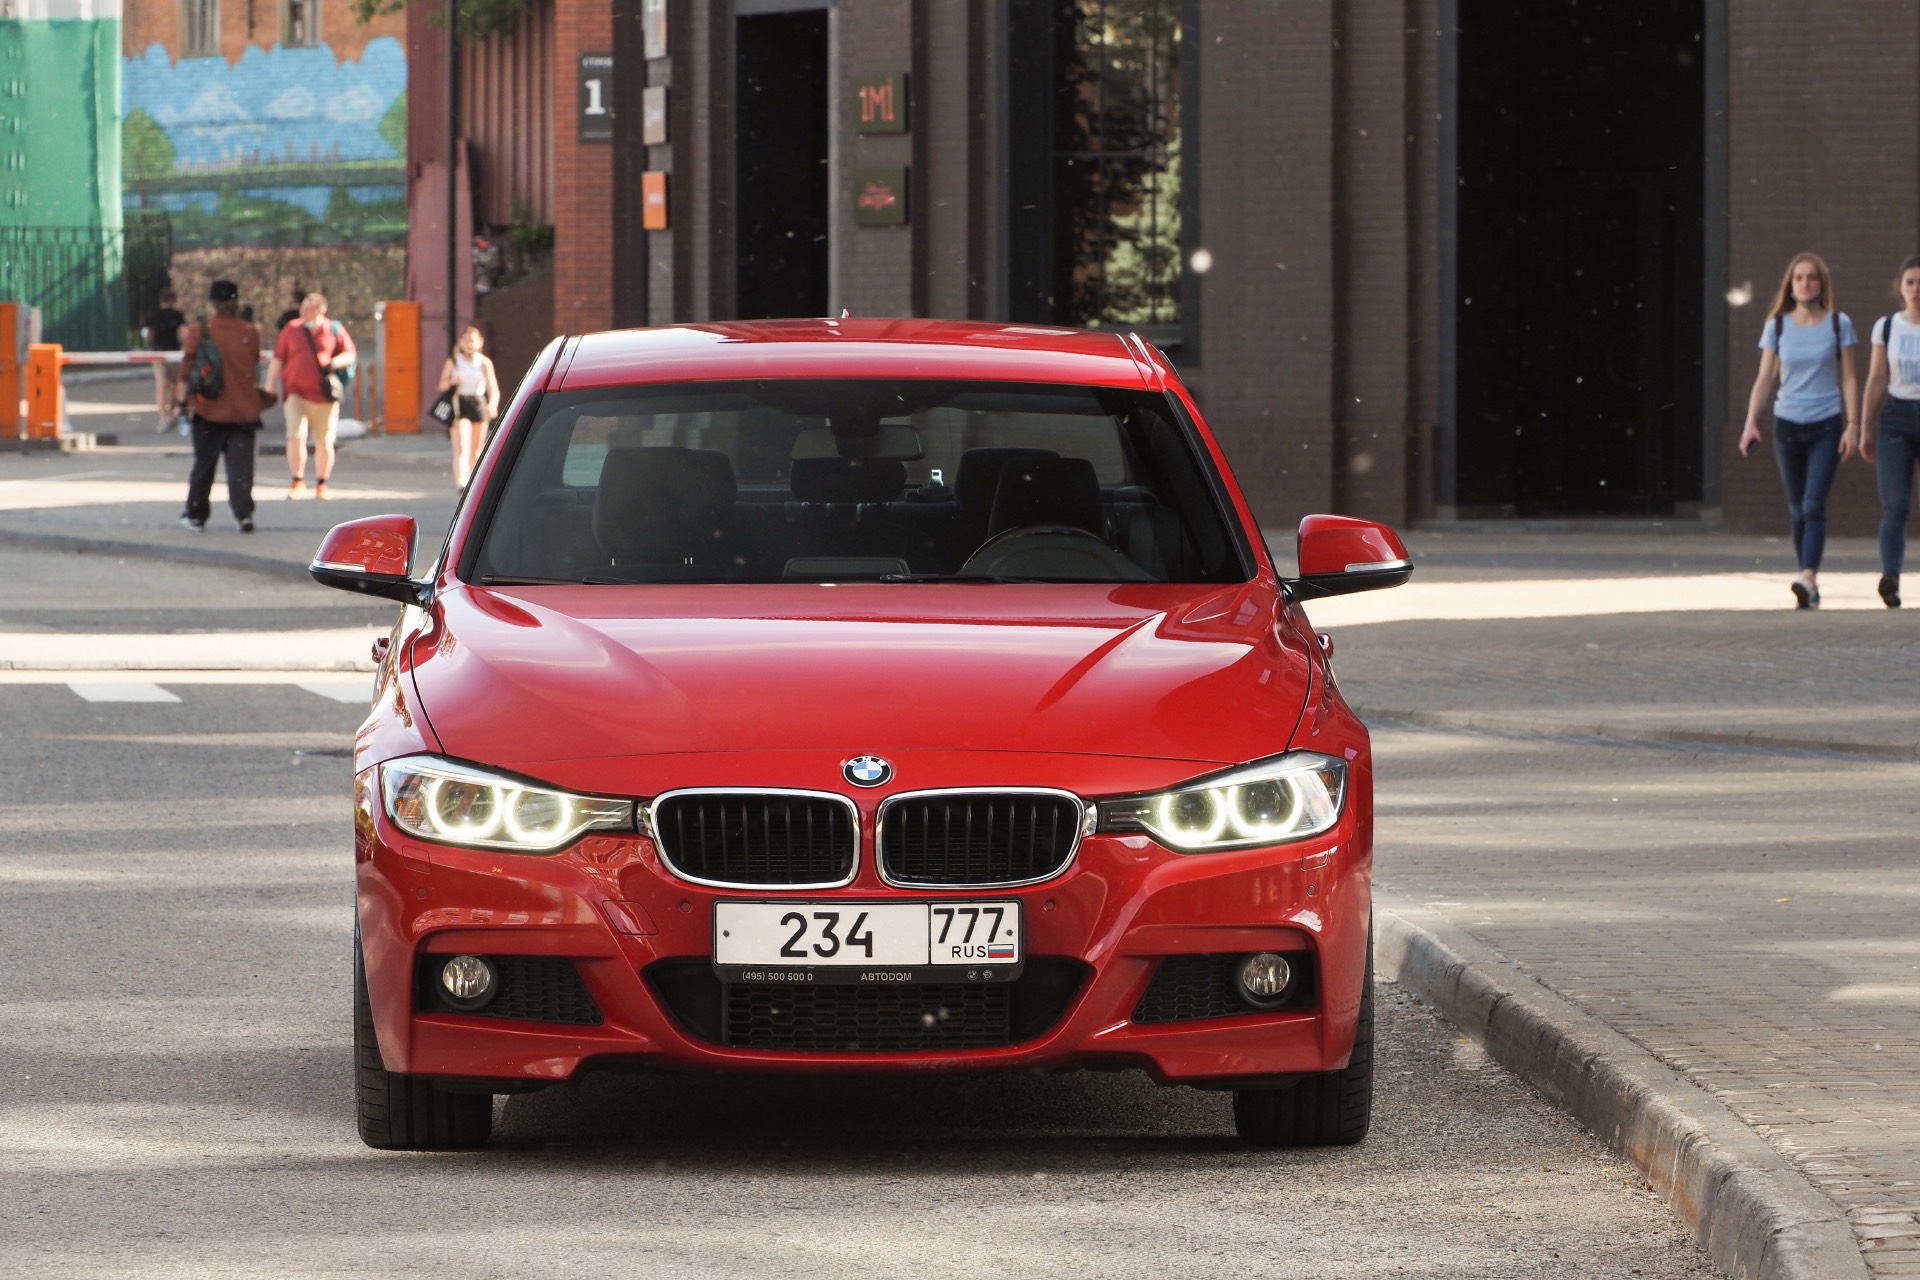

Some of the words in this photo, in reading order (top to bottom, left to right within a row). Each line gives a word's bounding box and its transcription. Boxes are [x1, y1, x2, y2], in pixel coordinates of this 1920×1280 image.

[585, 79, 606, 115] 1
[780, 911, 873, 958] 234
[933, 907, 1005, 944] 777
[951, 945, 987, 958] RUS
[742, 972, 766, 981] (495)
[768, 972, 785, 982] 500
[787, 972, 805, 982] 500
[807, 973, 813, 982] 0
